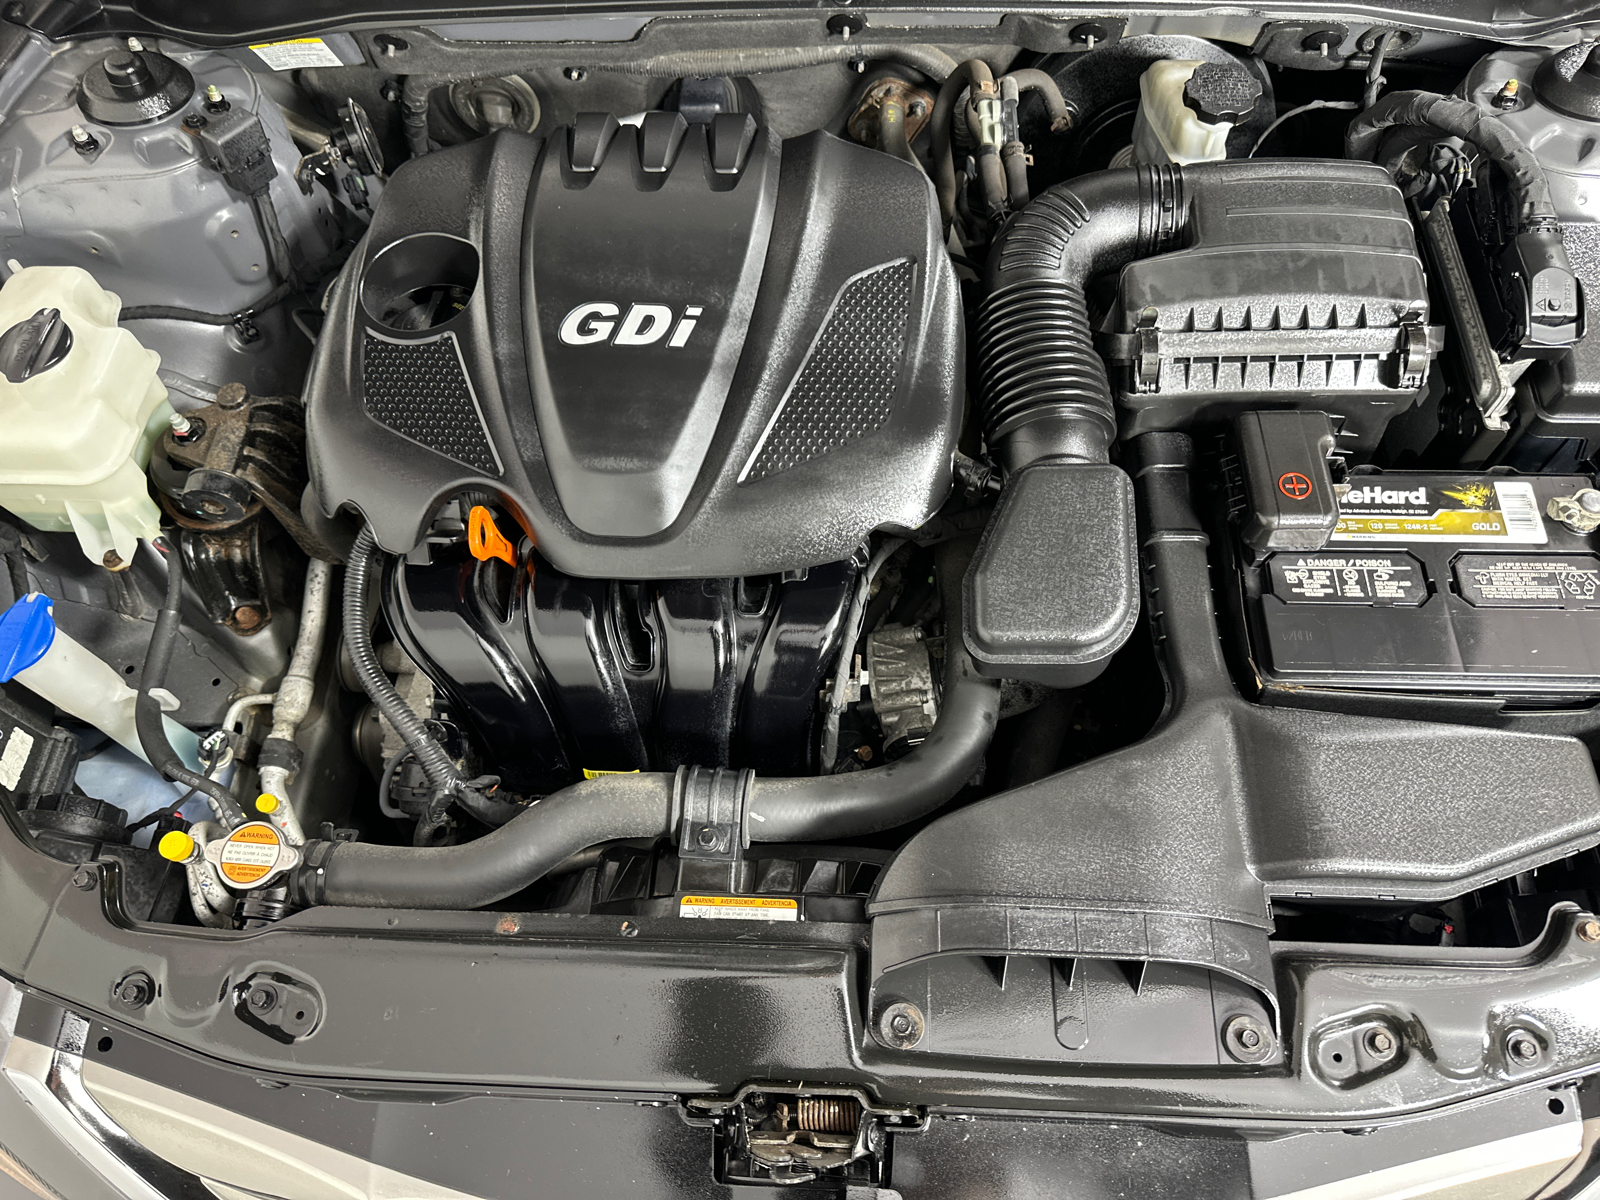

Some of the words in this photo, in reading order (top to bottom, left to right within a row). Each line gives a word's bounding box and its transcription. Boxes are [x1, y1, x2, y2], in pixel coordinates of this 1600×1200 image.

[559, 302, 703, 348] GDi
[1472, 523, 1500, 531] GOLD
[1307, 559, 1346, 567] DANGER
[1355, 559, 1391, 567] POISON
[246, 832, 274, 840] WARNING
